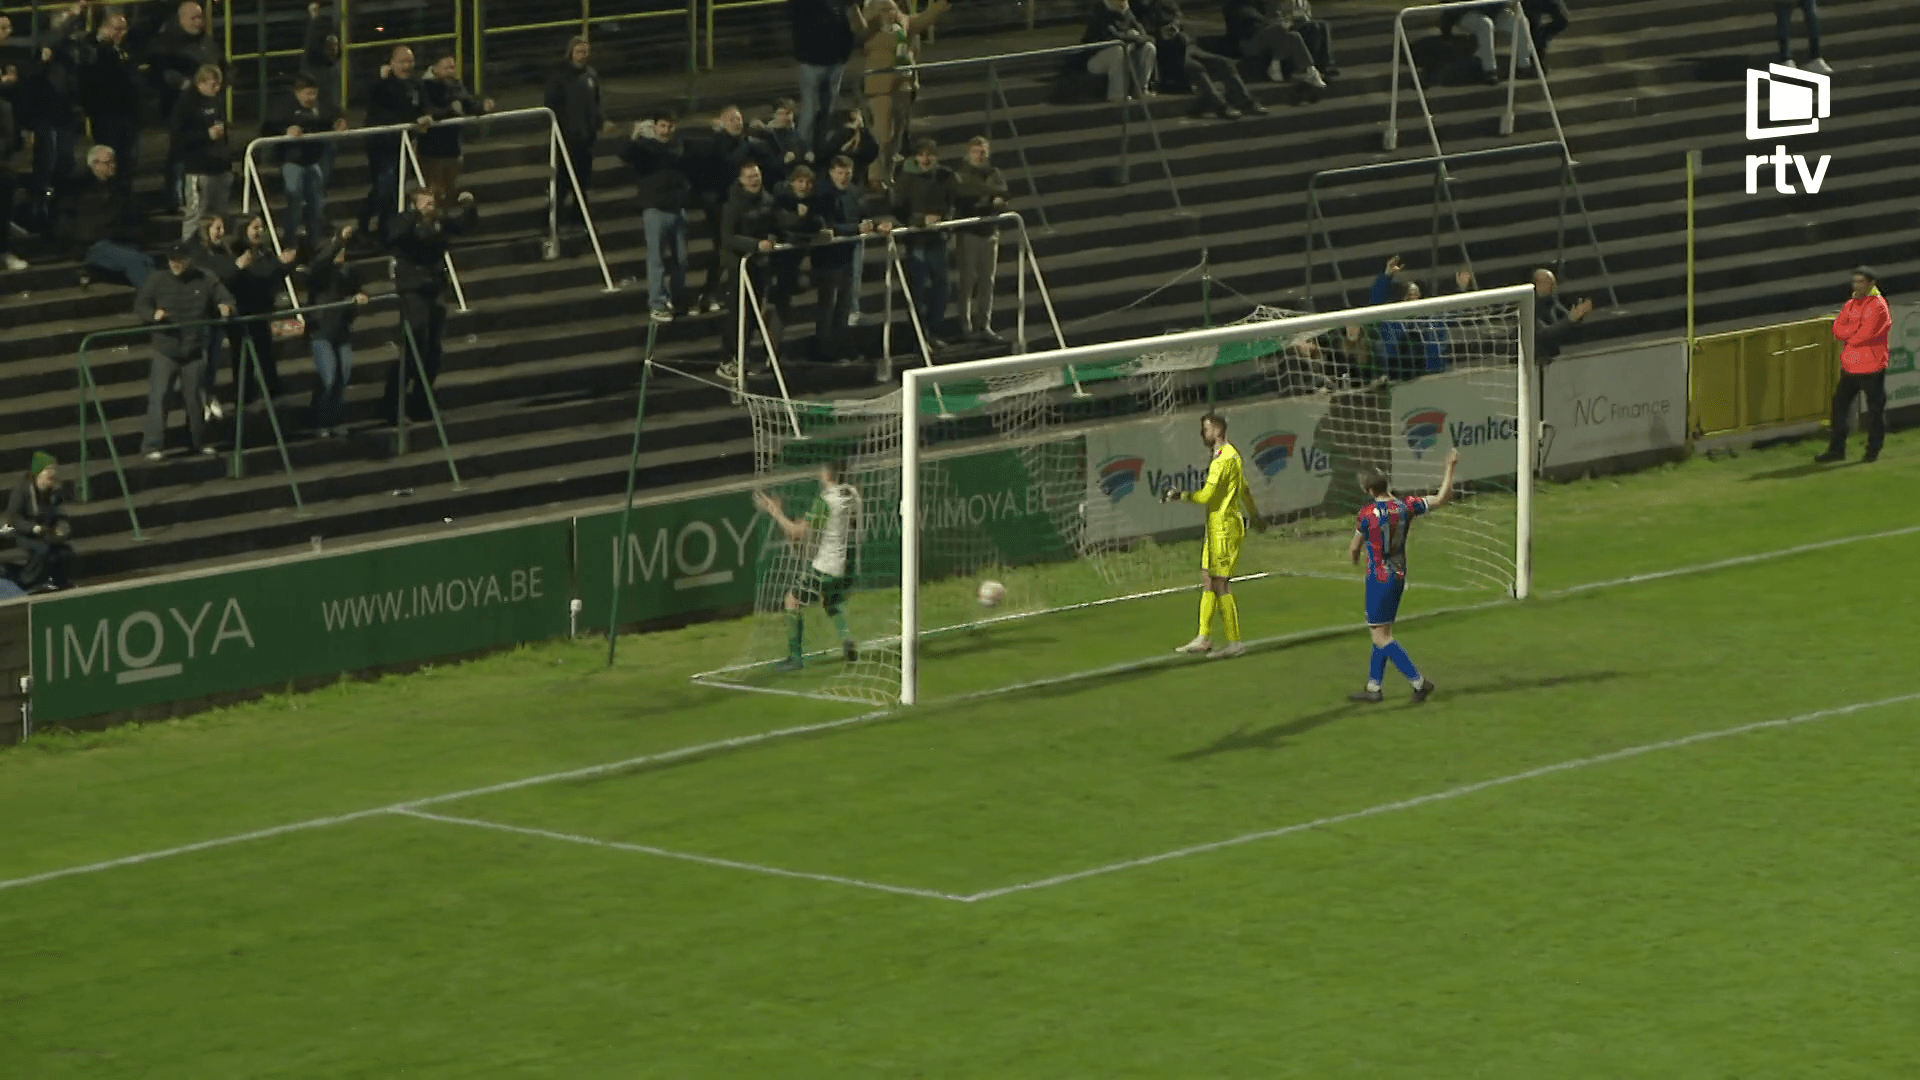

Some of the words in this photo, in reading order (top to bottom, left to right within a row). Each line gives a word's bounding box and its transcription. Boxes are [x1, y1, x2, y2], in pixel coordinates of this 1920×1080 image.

[1575, 395, 1608, 427] NC
[45, 598, 255, 683] IMOYA
[322, 566, 544, 632] WWW.IMOYA.BE
